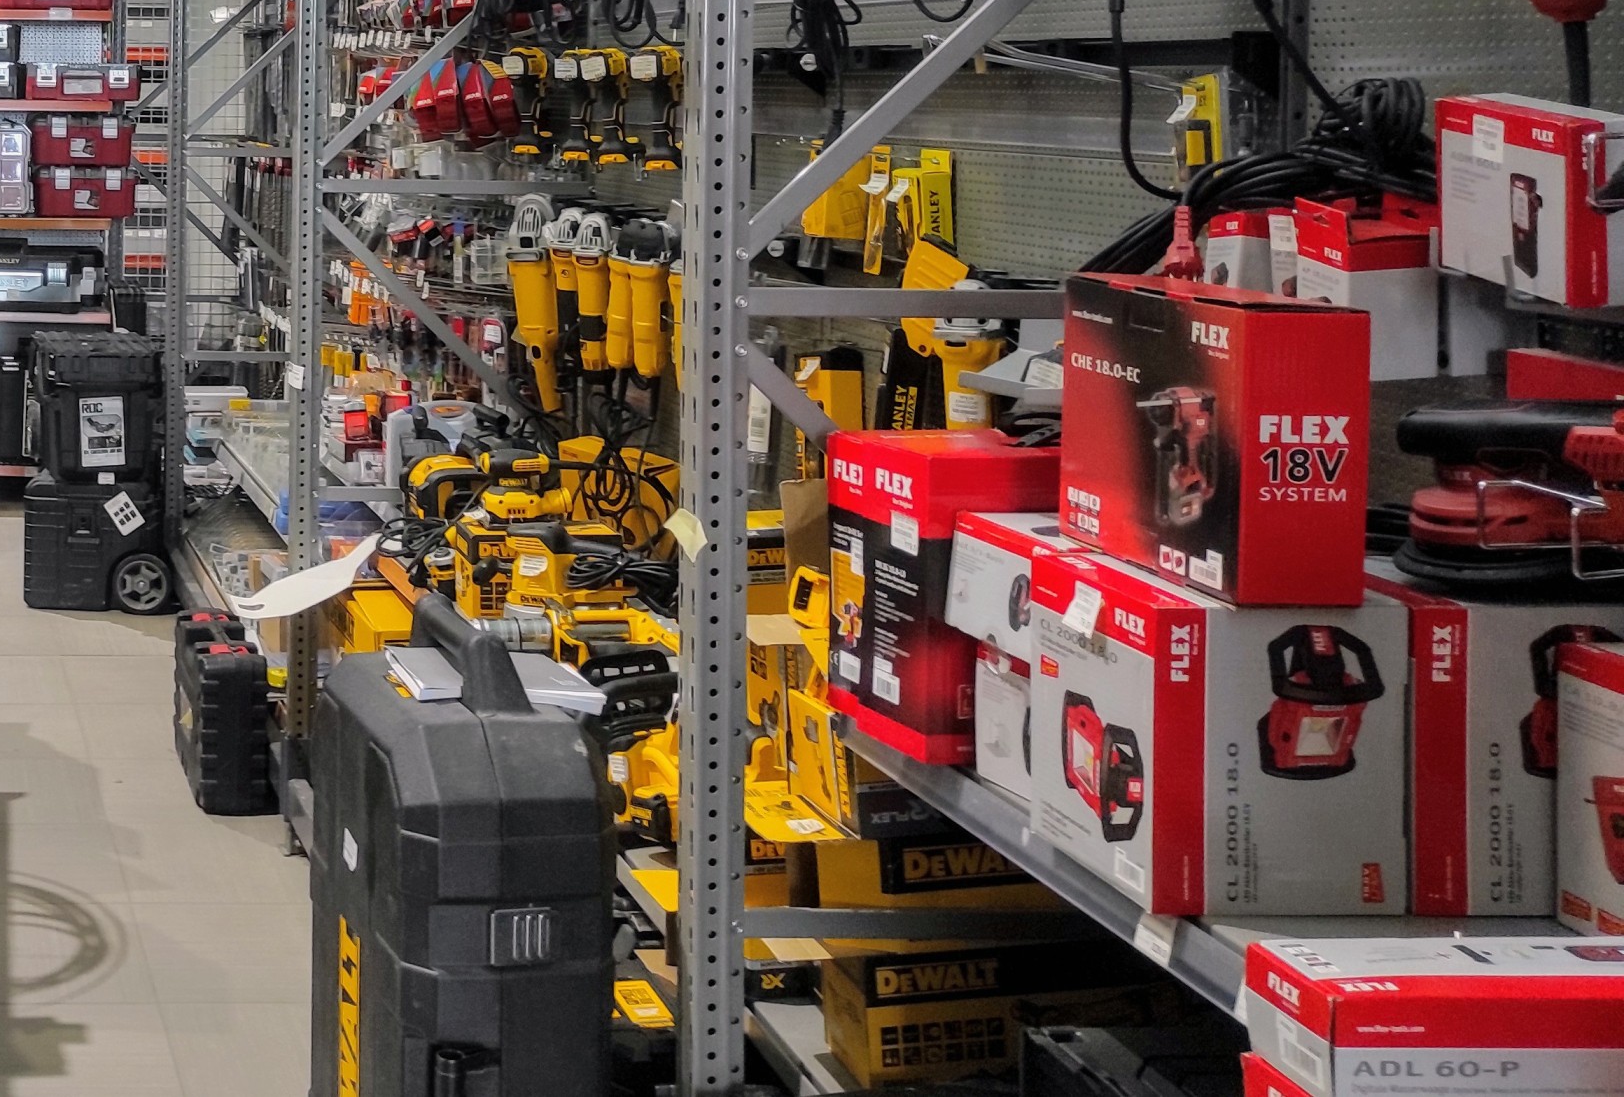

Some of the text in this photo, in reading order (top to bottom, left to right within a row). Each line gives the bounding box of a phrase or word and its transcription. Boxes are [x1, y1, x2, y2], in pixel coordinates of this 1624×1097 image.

[1532, 127, 1555, 144] FLEX
[1323, 246, 1343, 263] FLEX
[1190, 321, 1230, 350] FLEX
[1071, 352, 1141, 384] CHE 18.0-EC
[1258, 415, 1350, 444] FLEX
[1260, 447, 1349, 484] 18V
[874, 467, 914, 501] FLEX
[1258, 487, 1347, 502] SYSTEM
[1040, 618, 1054, 633] CL
[1113, 607, 1145, 638] FLEX
[1170, 624, 1191, 682] FLEX
[1432, 624, 1453, 682] FLEX
[1226, 741, 1239, 903] CL 2000 18.0
[1489, 741, 1502, 903] CL 2000 18.0
[876, 957, 998, 997] DEWALT
[1266, 971, 1301, 1007] FLEX
[1353, 1059, 1520, 1078] ADL 60-P
